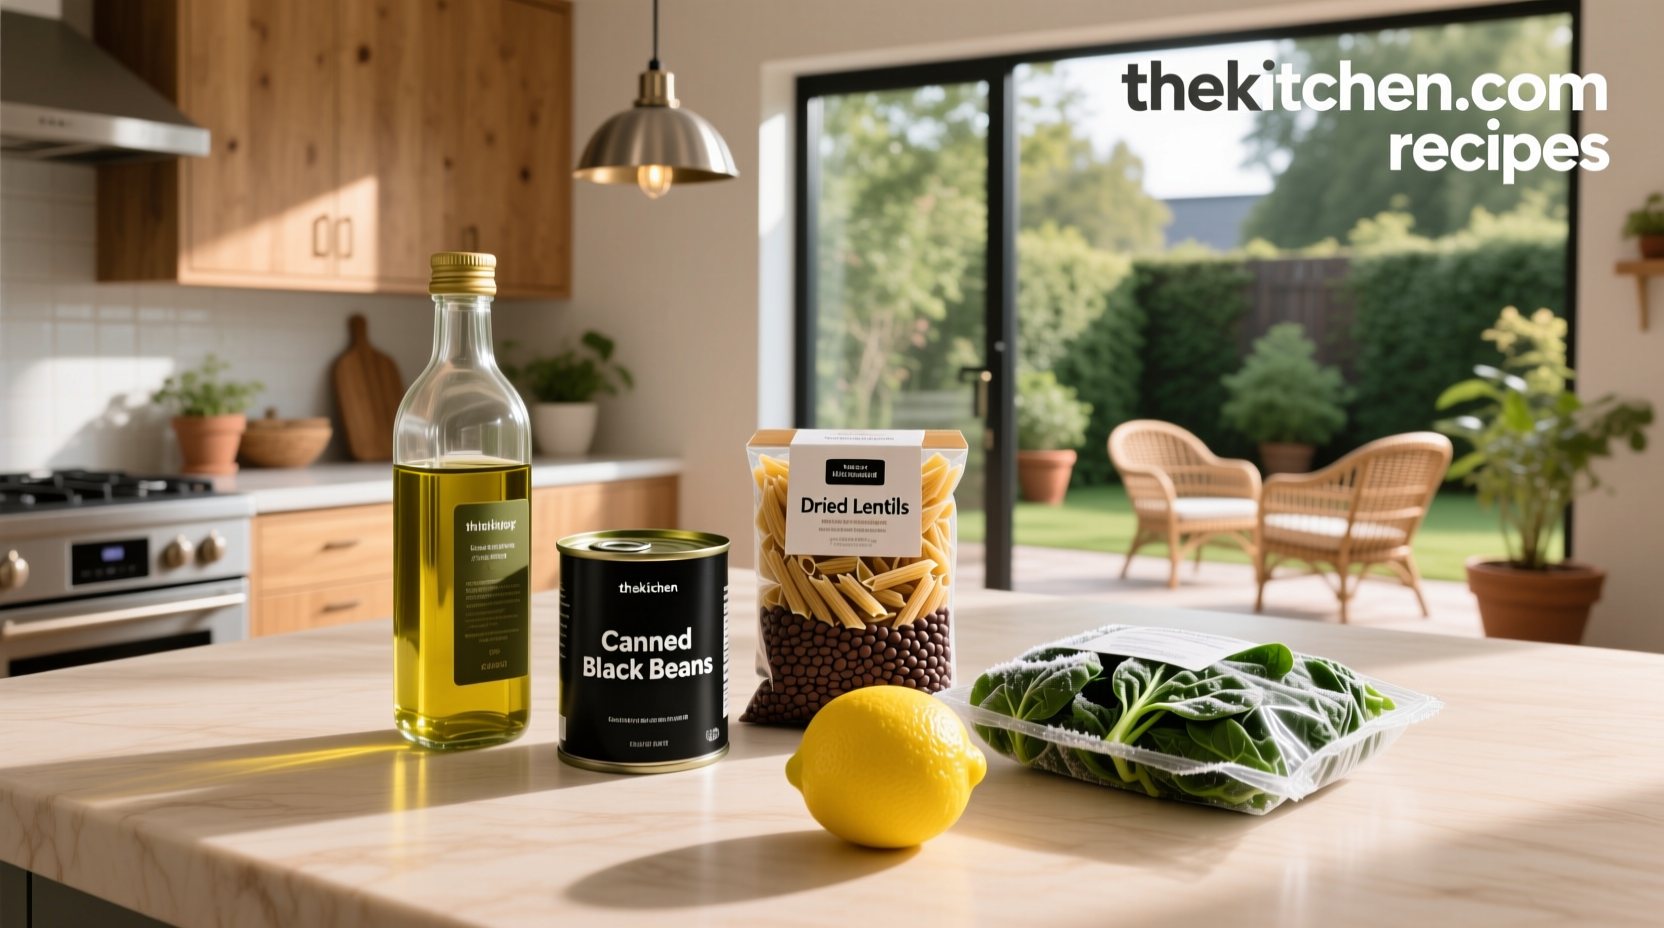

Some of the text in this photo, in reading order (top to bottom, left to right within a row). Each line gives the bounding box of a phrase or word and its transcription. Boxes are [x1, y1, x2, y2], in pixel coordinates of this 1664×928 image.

[801, 497, 910, 516] Dried Lentils
[601, 626, 692, 652] Canned
[583, 656, 713, 680] Black Beans
